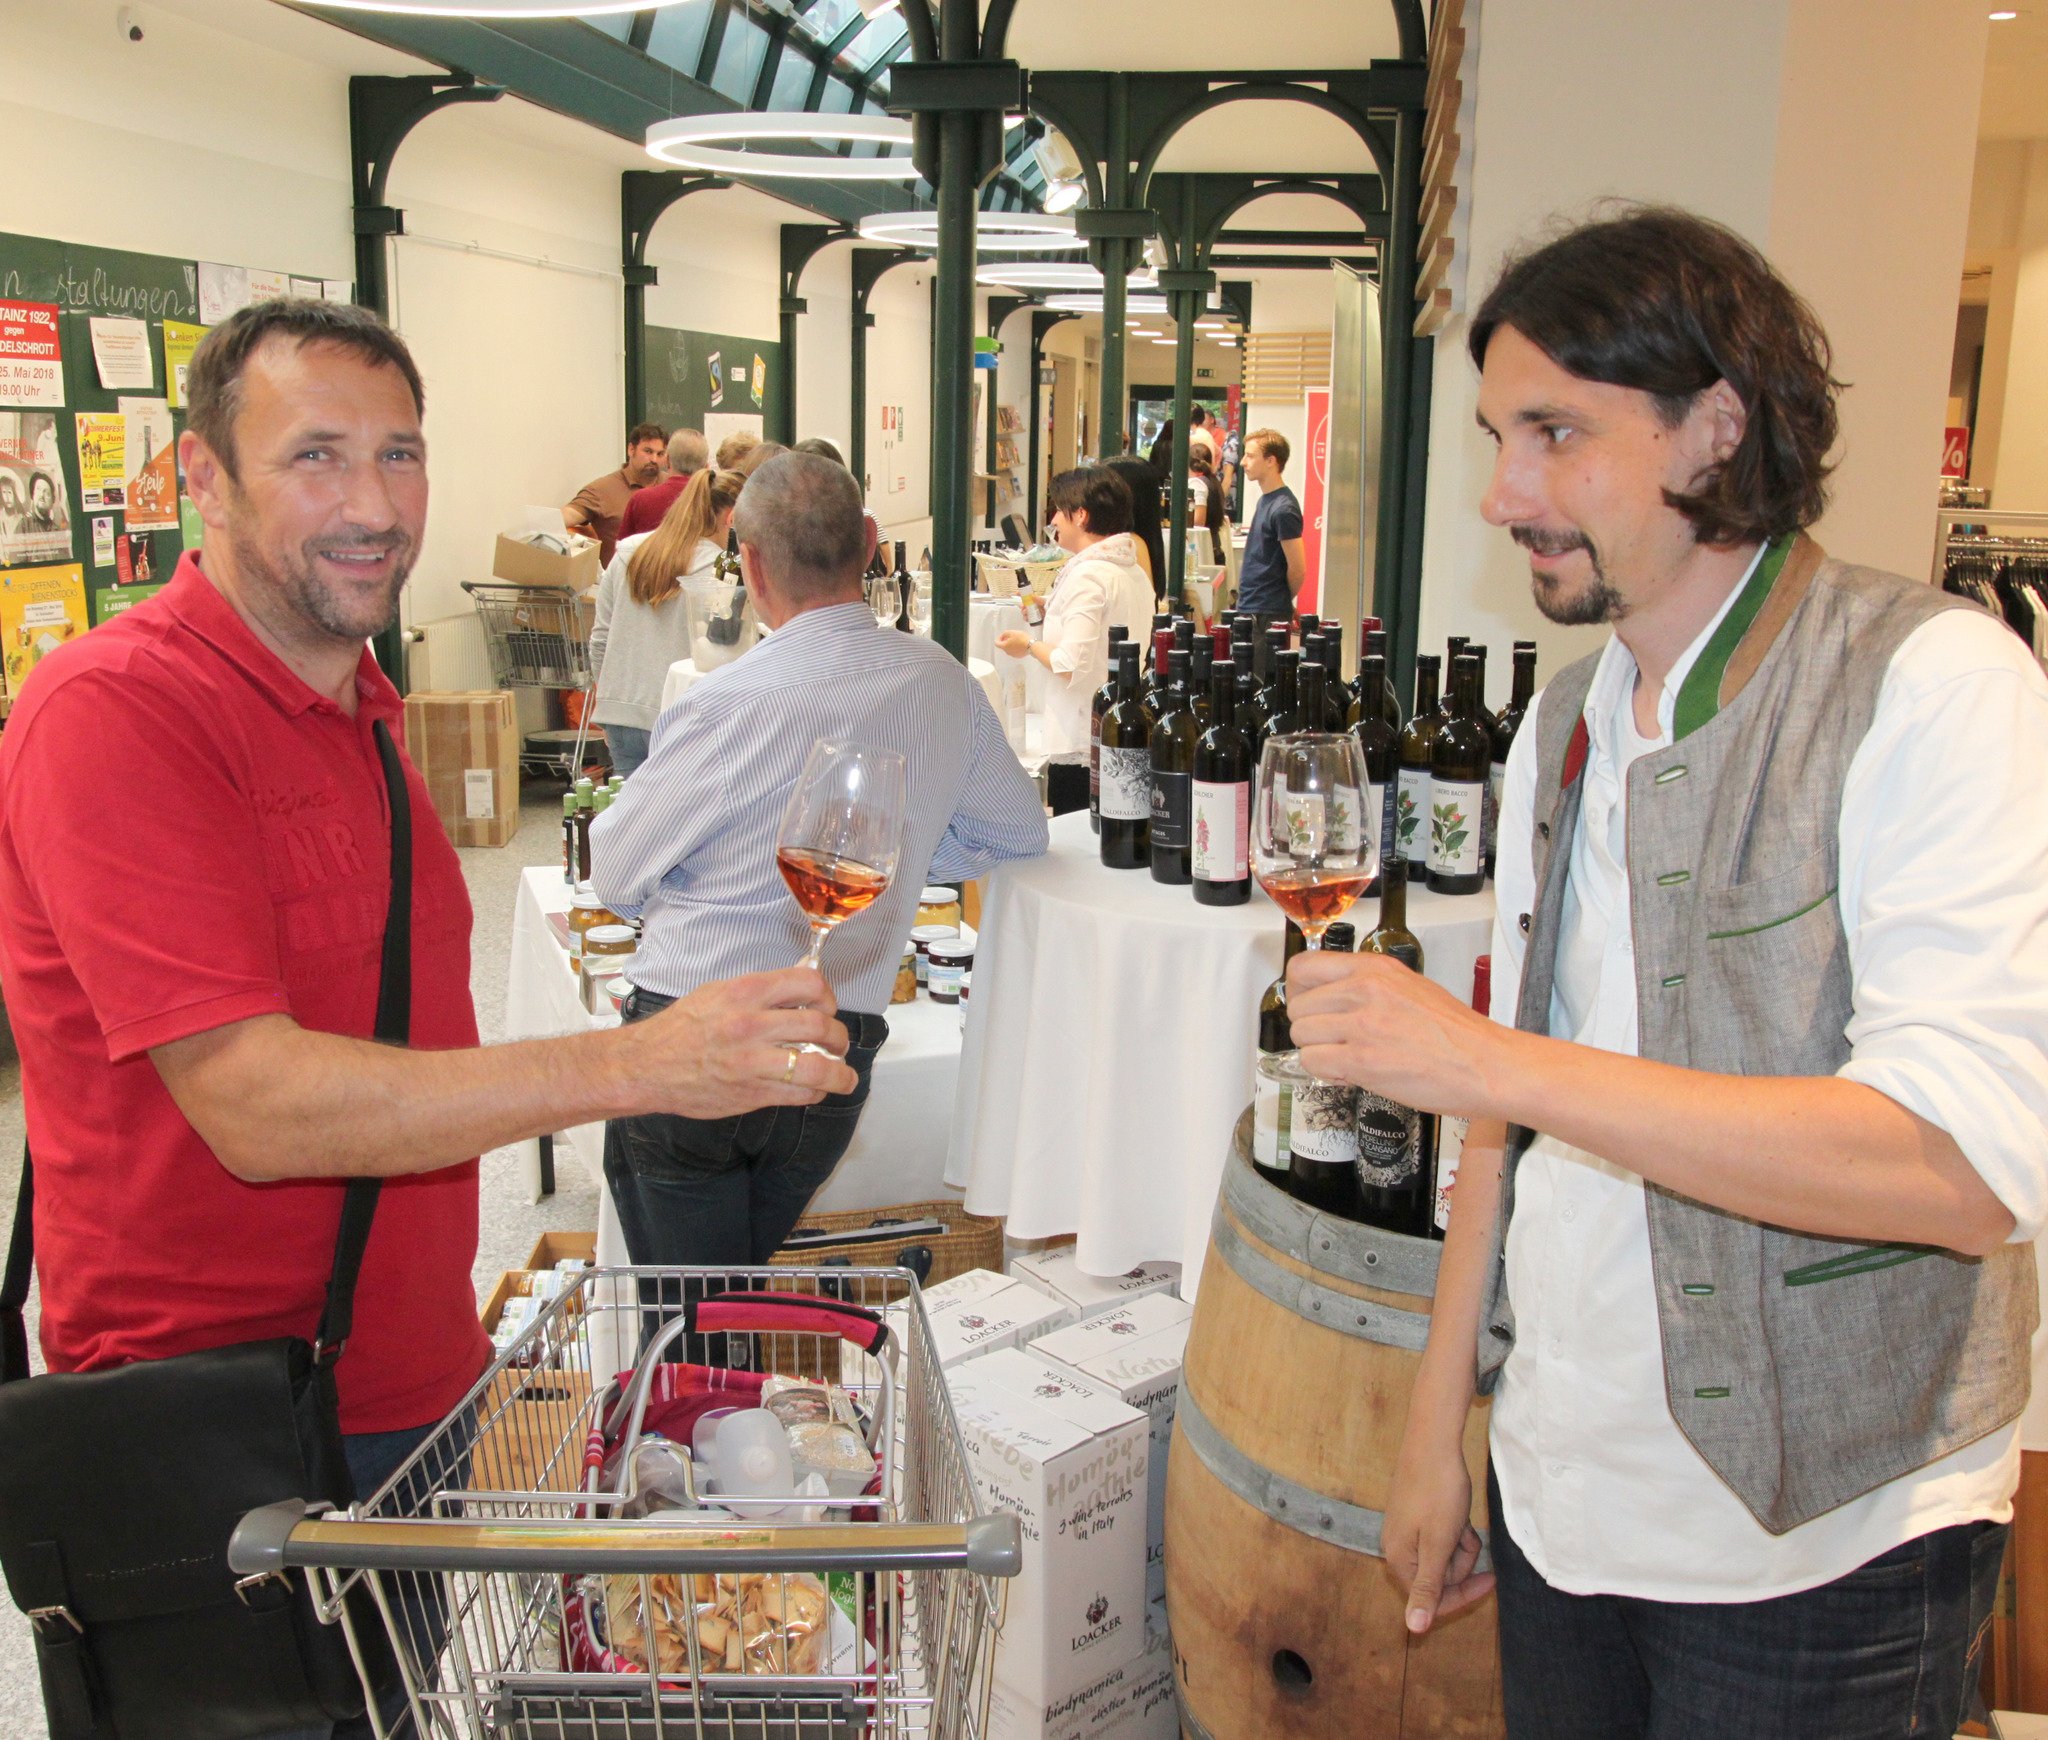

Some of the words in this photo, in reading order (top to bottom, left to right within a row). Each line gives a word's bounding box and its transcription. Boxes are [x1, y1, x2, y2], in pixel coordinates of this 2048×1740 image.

[29, 310, 51, 325] 1922
[4, 326, 25, 336] gegen
[0, 340, 55, 355] DELSCHROTT
[14, 366, 31, 379] Mai
[33, 367, 54, 379] 2018
[24, 384, 41, 396] Uhr
[1451, 789, 1468, 797] BACCO
[1291, 1139, 1330, 1158] ALDIFALCO
[1119, 1272, 1175, 1291] LOACKER
[1080, 1309, 1134, 1332] LOACKER
[961, 1319, 1017, 1344] LOACKER
[1042, 1370, 1094, 1399] LOACKER
[1016, 1430, 1053, 1447] Terroir
[1078, 1526, 1088, 1541] in
[1091, 1514, 1115, 1535] Italy
[1070, 1615, 1122, 1652] LOACKER
[1045, 1669, 1123, 1723] biodynamica
